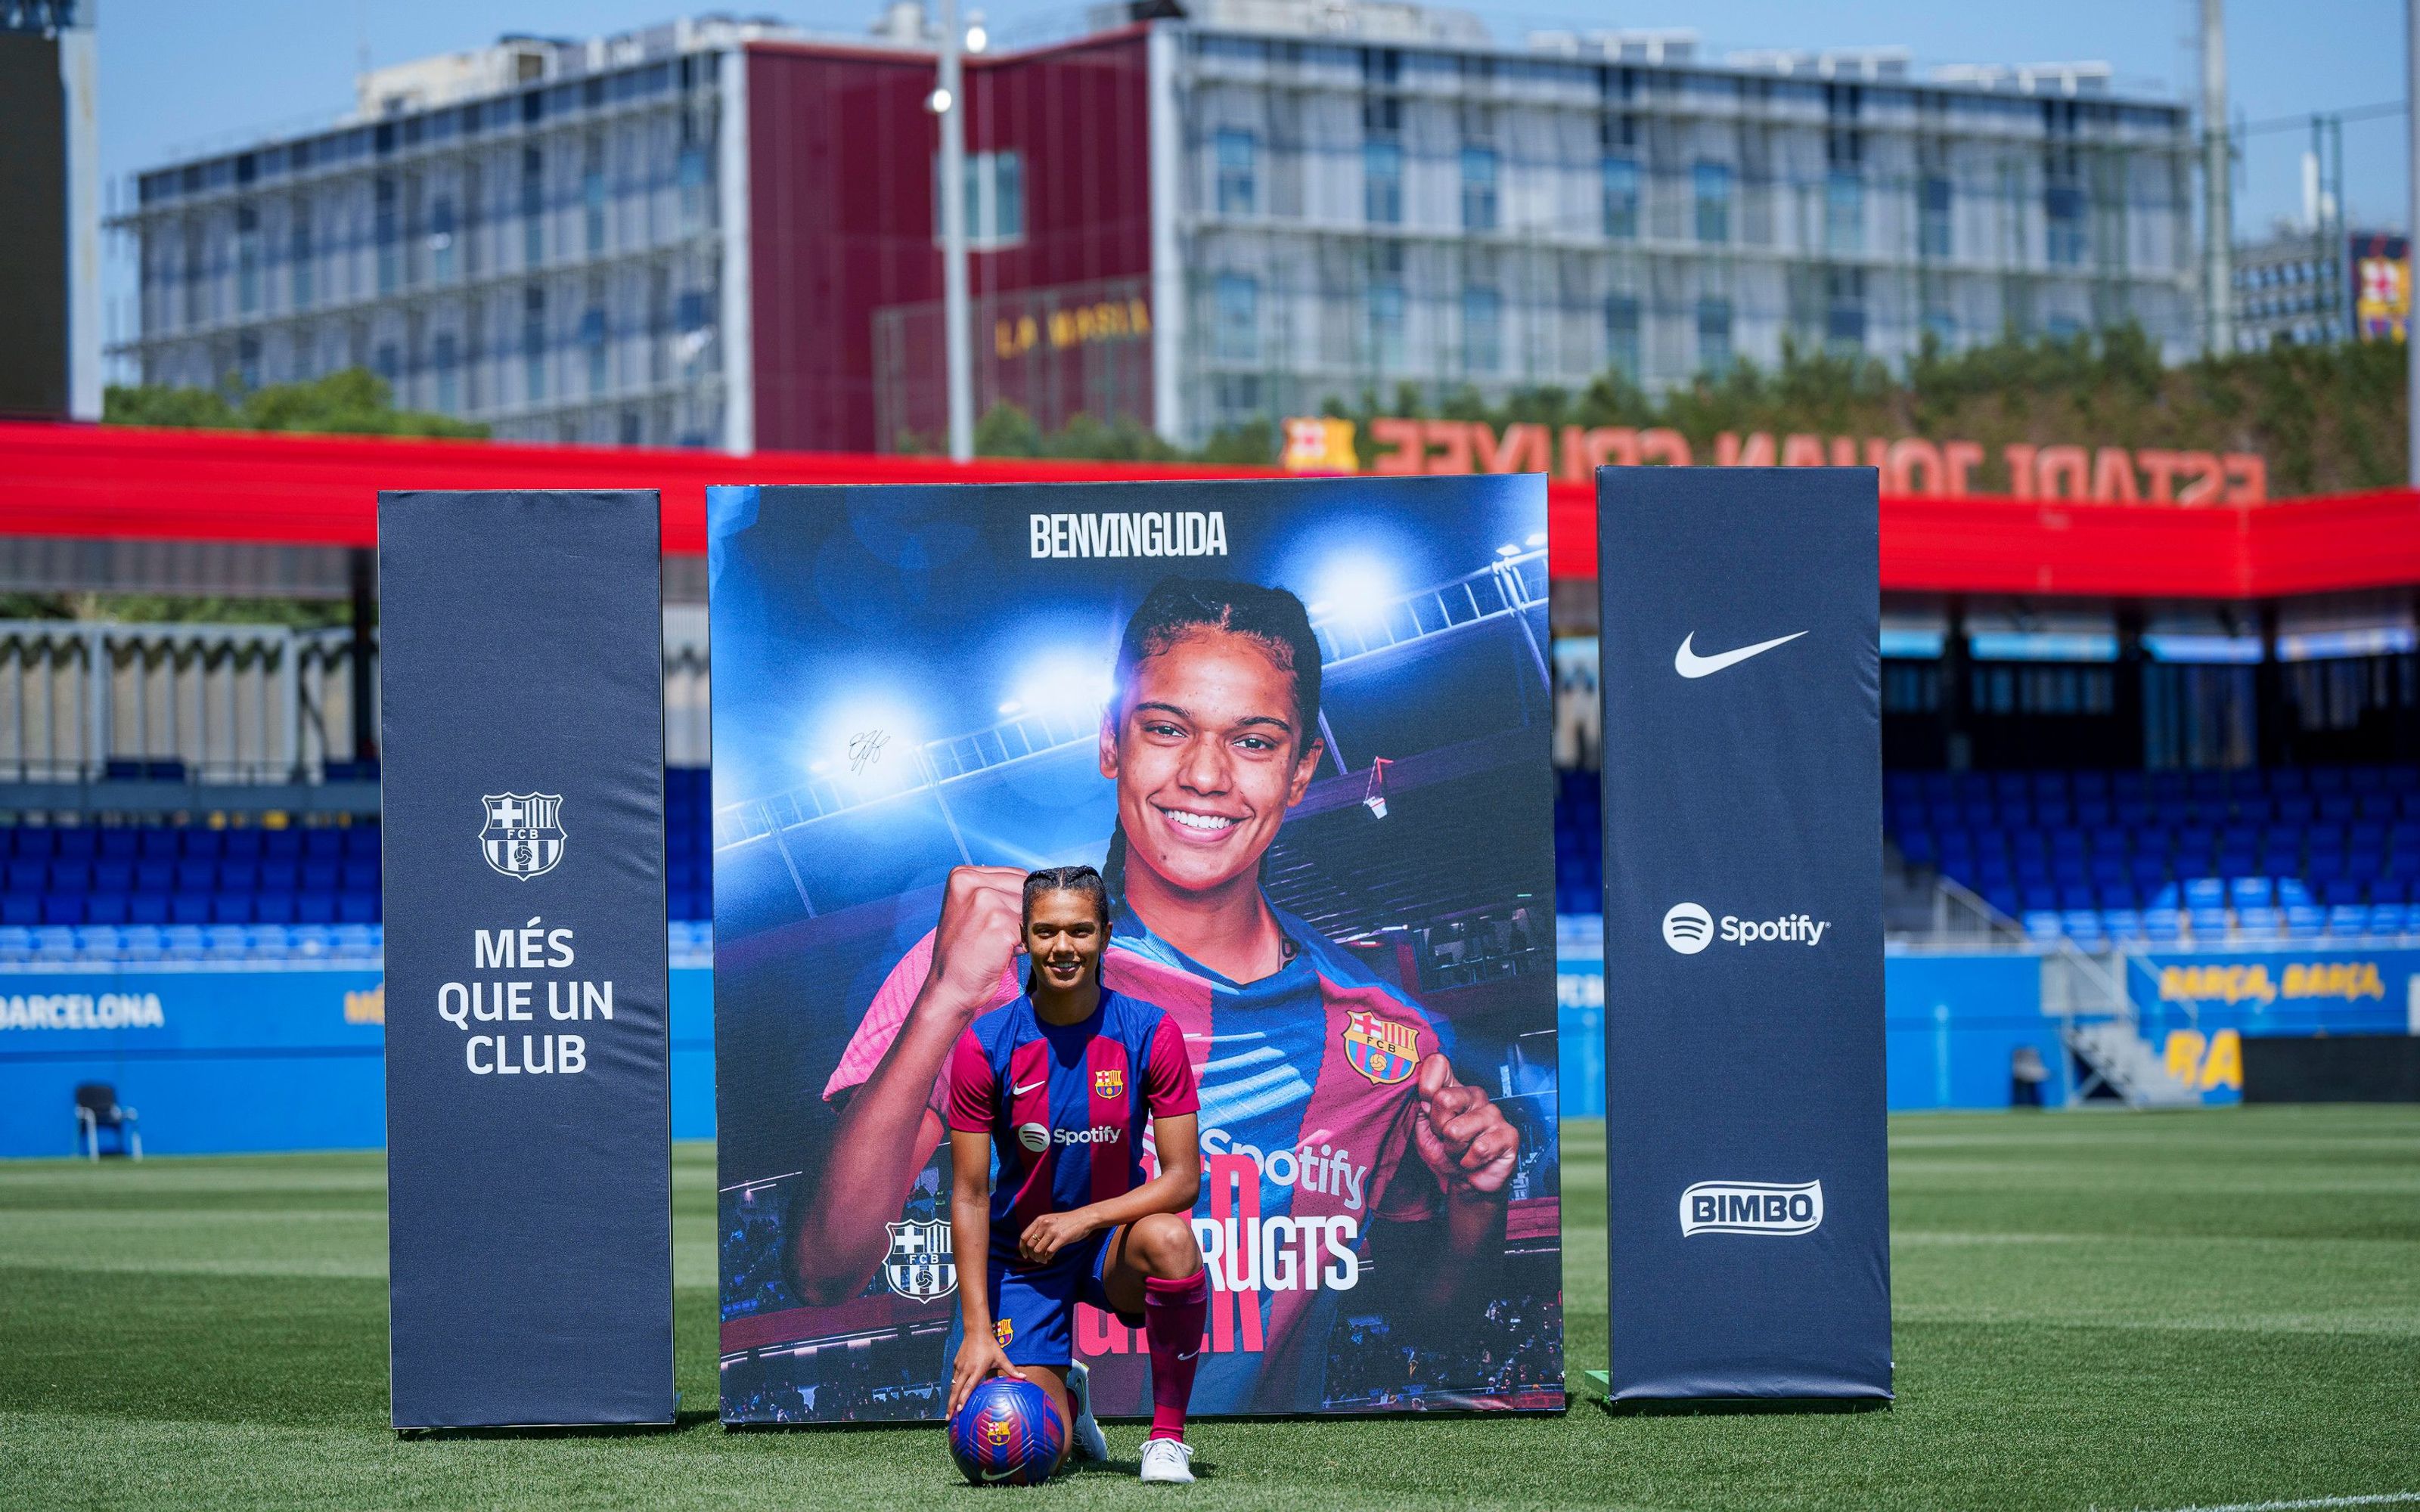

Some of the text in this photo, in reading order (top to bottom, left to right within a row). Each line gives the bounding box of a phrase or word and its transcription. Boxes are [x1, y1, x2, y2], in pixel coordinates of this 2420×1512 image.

[1029, 511, 1228, 559] BENVINGUDA
[507, 829, 539, 840] FCB
[475, 916, 575, 969] MÉS
[1720, 913, 1825, 946] Spotify
[438, 981, 613, 1030] QUE UN
[466, 1034, 586, 1075] CLUB
[1367, 1036, 1396, 1053] FCB
[1053, 1125, 1122, 1146] Spotify
[1692, 1194, 1813, 1222] BIMBO
[909, 1254, 939, 1264] FCB
